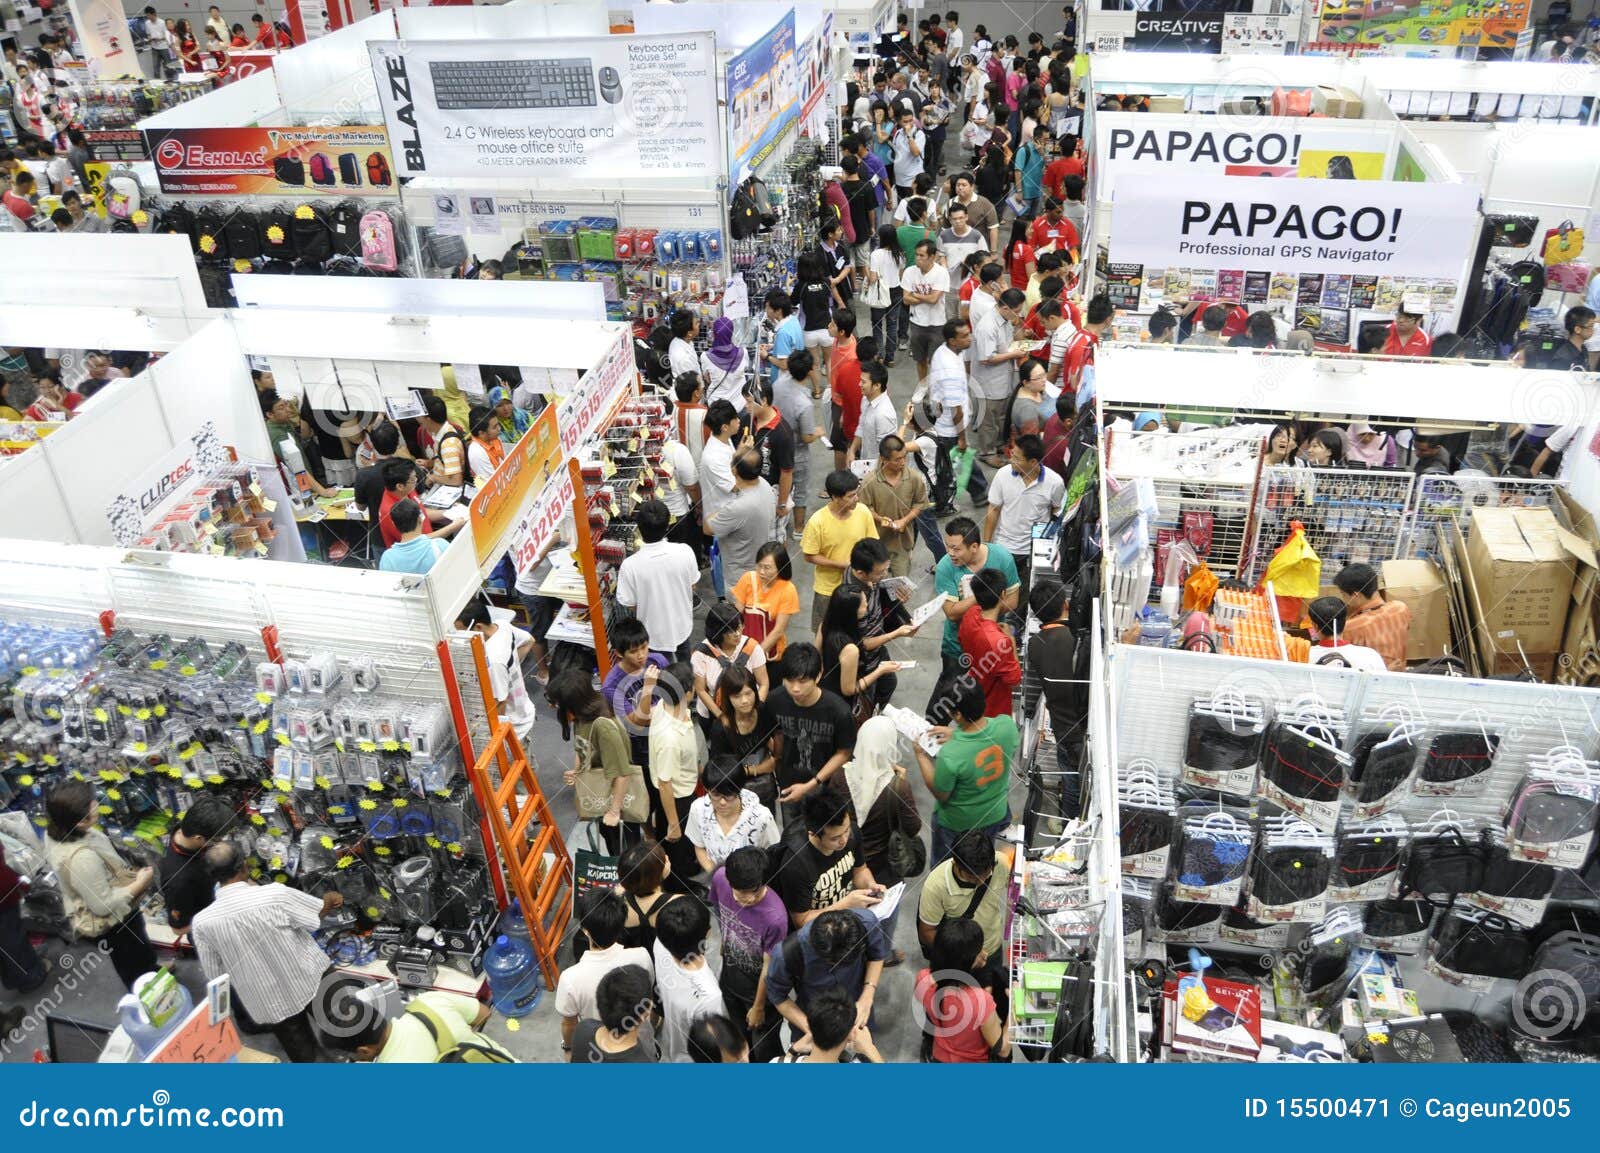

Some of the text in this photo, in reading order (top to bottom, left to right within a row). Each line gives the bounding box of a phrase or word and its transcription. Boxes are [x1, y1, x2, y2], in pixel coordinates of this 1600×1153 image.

[1137, 20, 1221, 35] CREATIVE
[628, 41, 697, 53] Keyboard and
[629, 53, 660, 61] Mouse
[386, 55, 426, 171] BLAZE
[342, 131, 385, 141] Marketing
[464, 126, 476, 139] G
[478, 126, 526, 139] Wireless
[528, 125, 586, 142] keyboard
[590, 125, 614, 138] and
[477, 140, 585, 154] mouse office suite
[1108, 128, 1301, 165] PAPAGO!
[549, 205, 566, 214] BHD
[688, 208, 702, 216] 131
[1181, 200, 1402, 243] PAPAGO!
[1179, 241, 1395, 264] Professional GPS Navigator
[776, 714, 834, 735] THE GUARD
[975, 744, 1005, 787] 3
